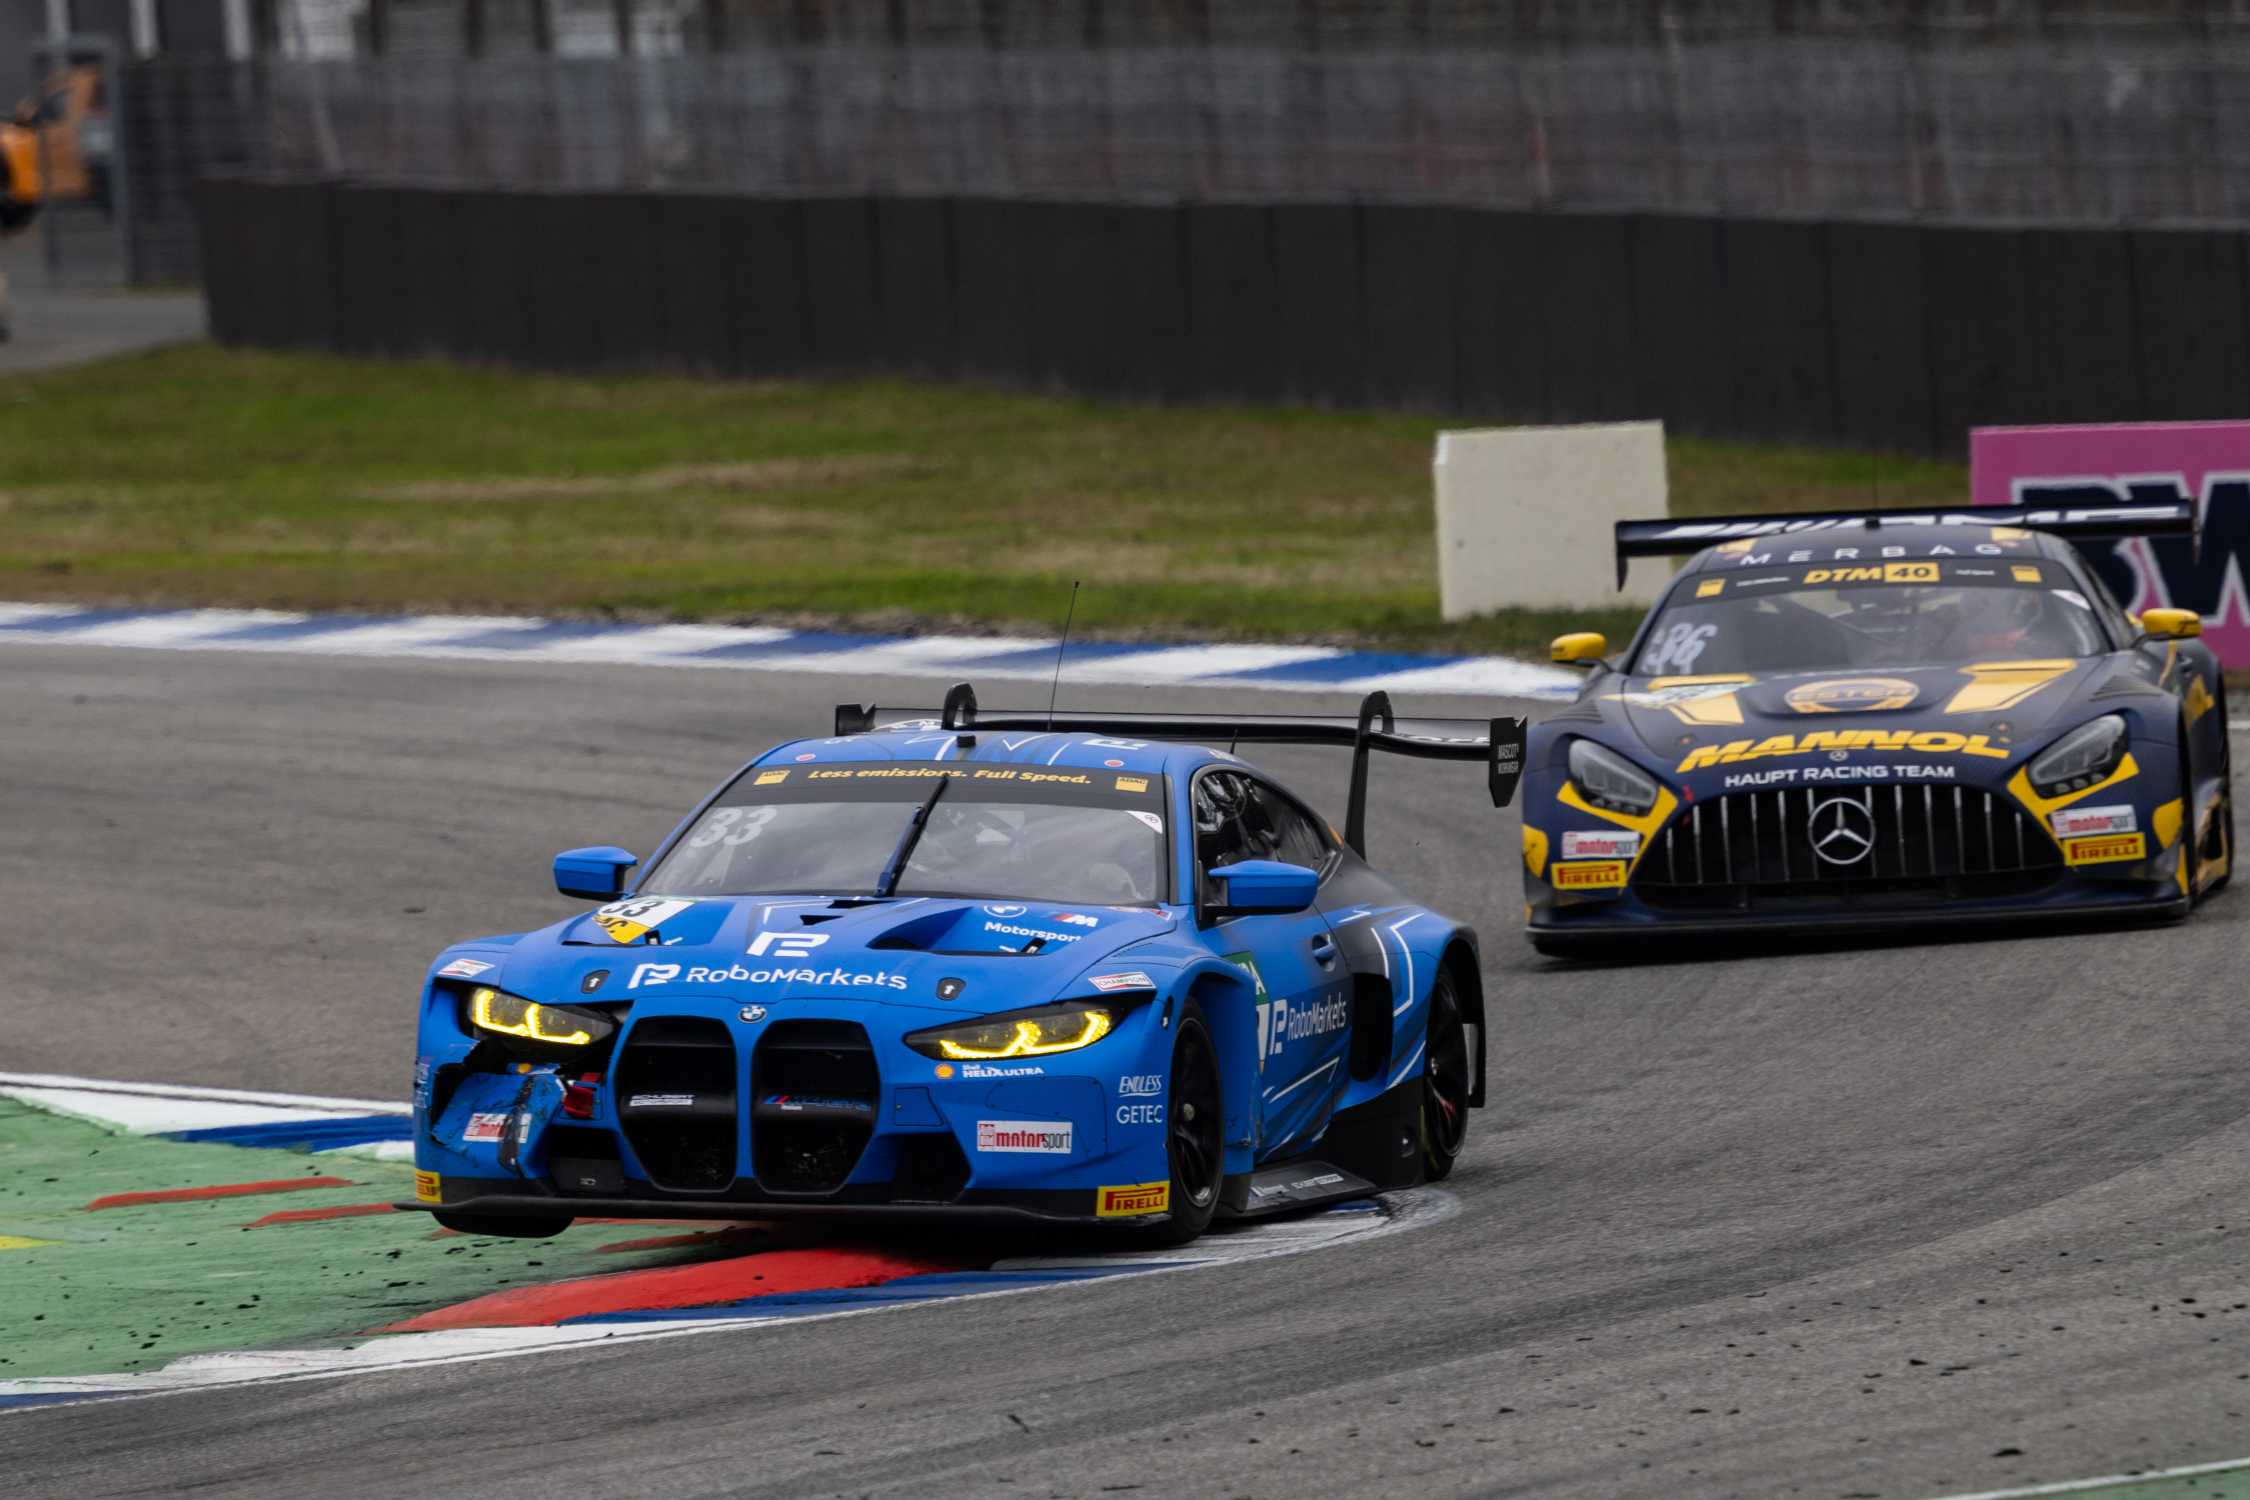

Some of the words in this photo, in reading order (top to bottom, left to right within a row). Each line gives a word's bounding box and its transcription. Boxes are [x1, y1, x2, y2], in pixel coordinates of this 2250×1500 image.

[1740, 543, 2002, 565] MERBAG
[1803, 567, 1885, 584] DTM
[1892, 566, 1932, 579] 40
[1675, 730, 2010, 773] MANNOL
[808, 770, 853, 780] Less
[856, 767, 968, 779] emissions.
[974, 769, 1017, 780] Full
[1018, 771, 1092, 785] Speed.
[1725, 768, 1798, 788] HAUPT
[1803, 765, 1888, 781] RACING
[1893, 765, 1955, 779] TEAM
[689, 807, 777, 847] 33
[2070, 838, 2138, 860] PIRELLI
[1558, 864, 1619, 885] PIRELLI
[686, 964, 908, 990] RoboMarkets
[1287, 991, 1346, 1041] RoboMarkets
[1118, 1075, 1162, 1094] ENDLESS
[1116, 1105, 1163, 1124] GETEC
[1104, 1186, 1165, 1211] PIRELLI
